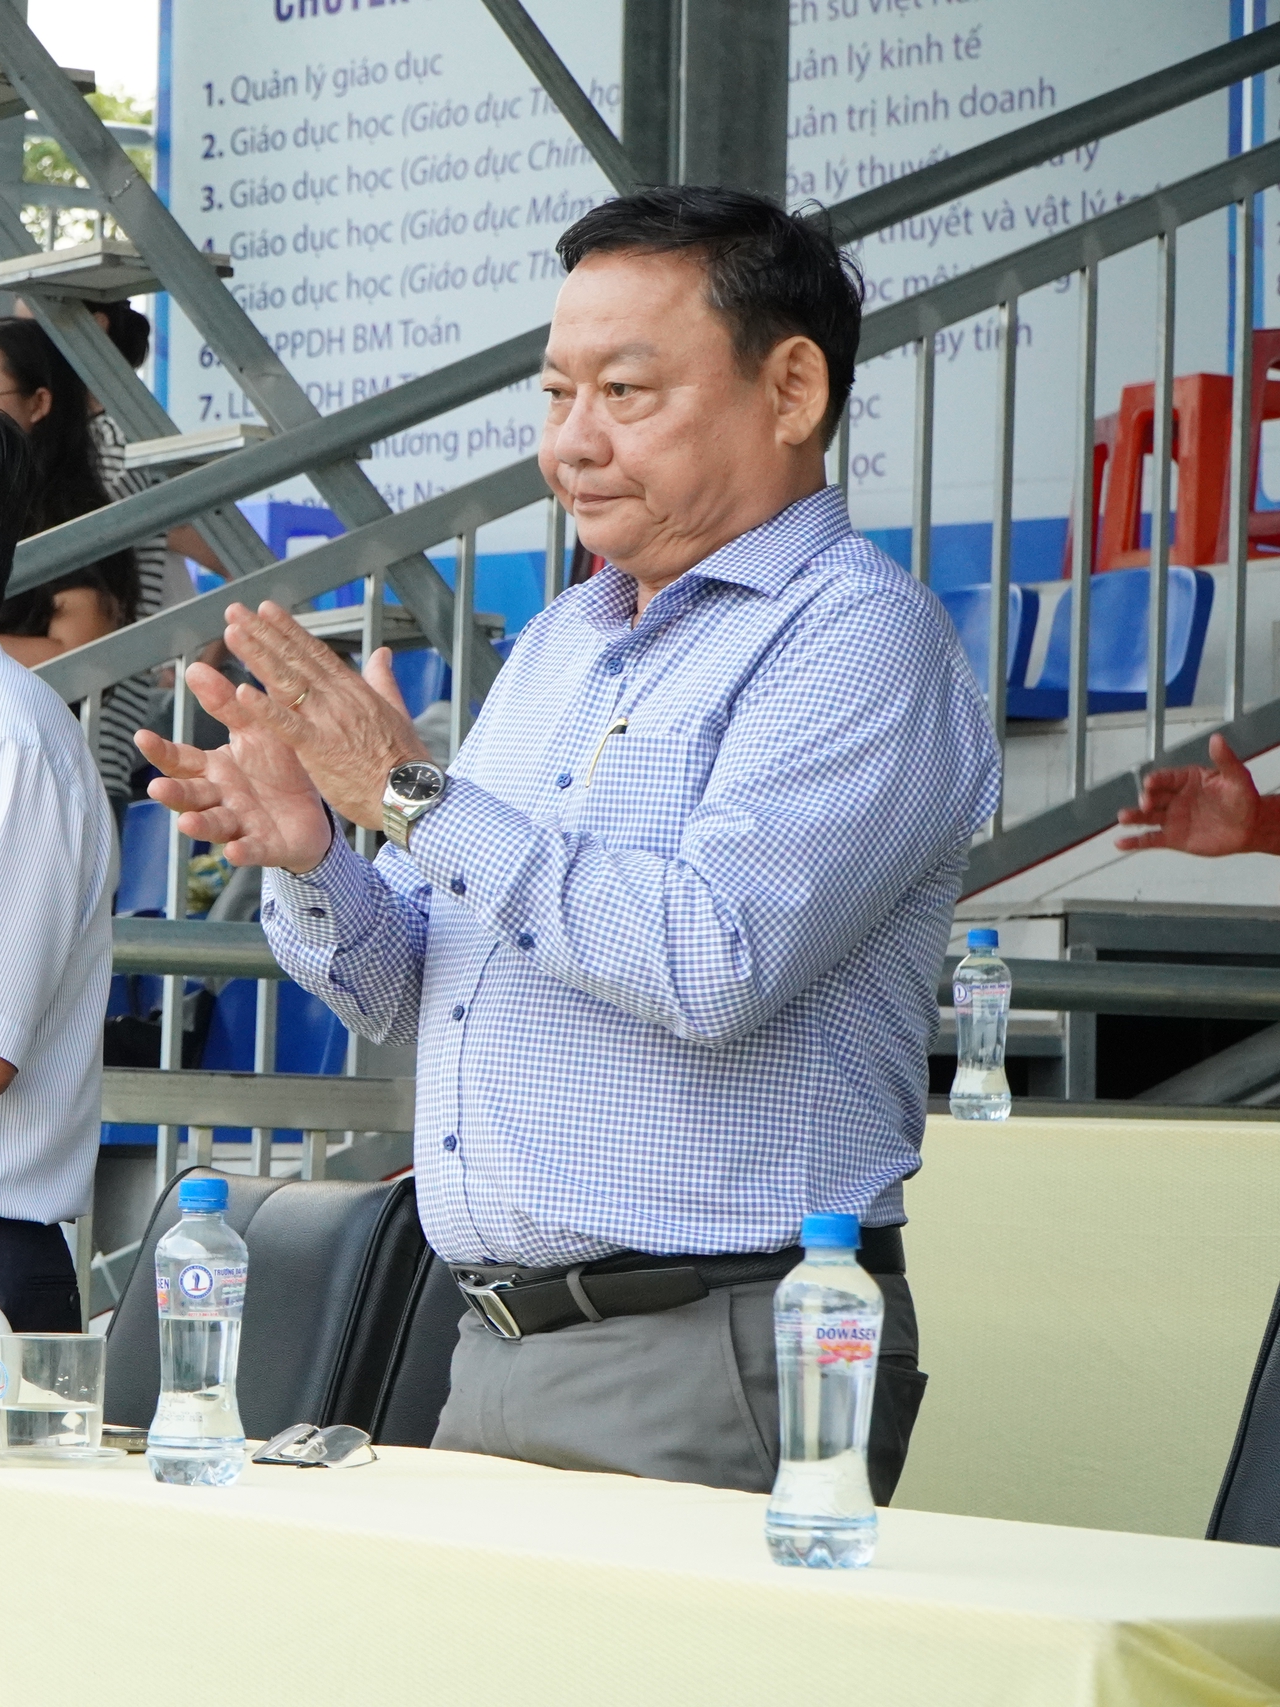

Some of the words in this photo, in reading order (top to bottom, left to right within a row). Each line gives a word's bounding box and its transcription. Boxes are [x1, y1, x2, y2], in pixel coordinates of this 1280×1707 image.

[789, 48, 837, 82] uản
[847, 42, 871, 83] lý
[880, 32, 943, 70] kinh
[953, 23, 982, 61] tế
[203, 81, 225, 107] 1.
[230, 69, 297, 106] Quản
[305, 63, 326, 101] lý
[332, 57, 388, 97] giáo
[395, 50, 442, 84] dục
[201, 133, 224, 160] 2.
[230, 124, 287, 156] Giáo
[293, 118, 340, 151] dục
[347, 112, 395, 145] học
[401, 98, 469, 137] (Giáo
[474, 91, 521, 127] dục
[788, 104, 837, 139] uản
[847, 98, 876, 138] trị
[887, 89, 949, 127] kinh
[959, 76, 1055, 118] doanh
[200, 185, 224, 212] 3.
[229, 176, 287, 209] Giáo
[292, 170, 339, 205] dục
[347, 164, 394, 199] học
[401, 154, 469, 191] (Giáo
[474, 146, 521, 182] dục
[528, 136, 594, 172] Chín
[825, 158, 848, 198] lý
[229, 229, 287, 261] Giáo
[292, 223, 340, 259] dục
[347, 217, 394, 252] học
[400, 208, 468, 245] (Giáo
[473, 200, 520, 236] dục
[981, 201, 1015, 232] và
[1025, 194, 1071, 238] vật
[230, 281, 286, 313] Giáo
[292, 275, 339, 311] dục
[346, 270, 393, 304] học
[400, 261, 467, 298] (Giáo
[472, 255, 520, 293] dục
[352, 323, 393, 354] BM
[401, 316, 460, 347] Toán
[199, 396, 221, 420] 7.
[848, 394, 881, 428] ọc
[372, 430, 459, 461] hương
[468, 417, 536, 458] pháp
[851, 451, 886, 485] ọc
